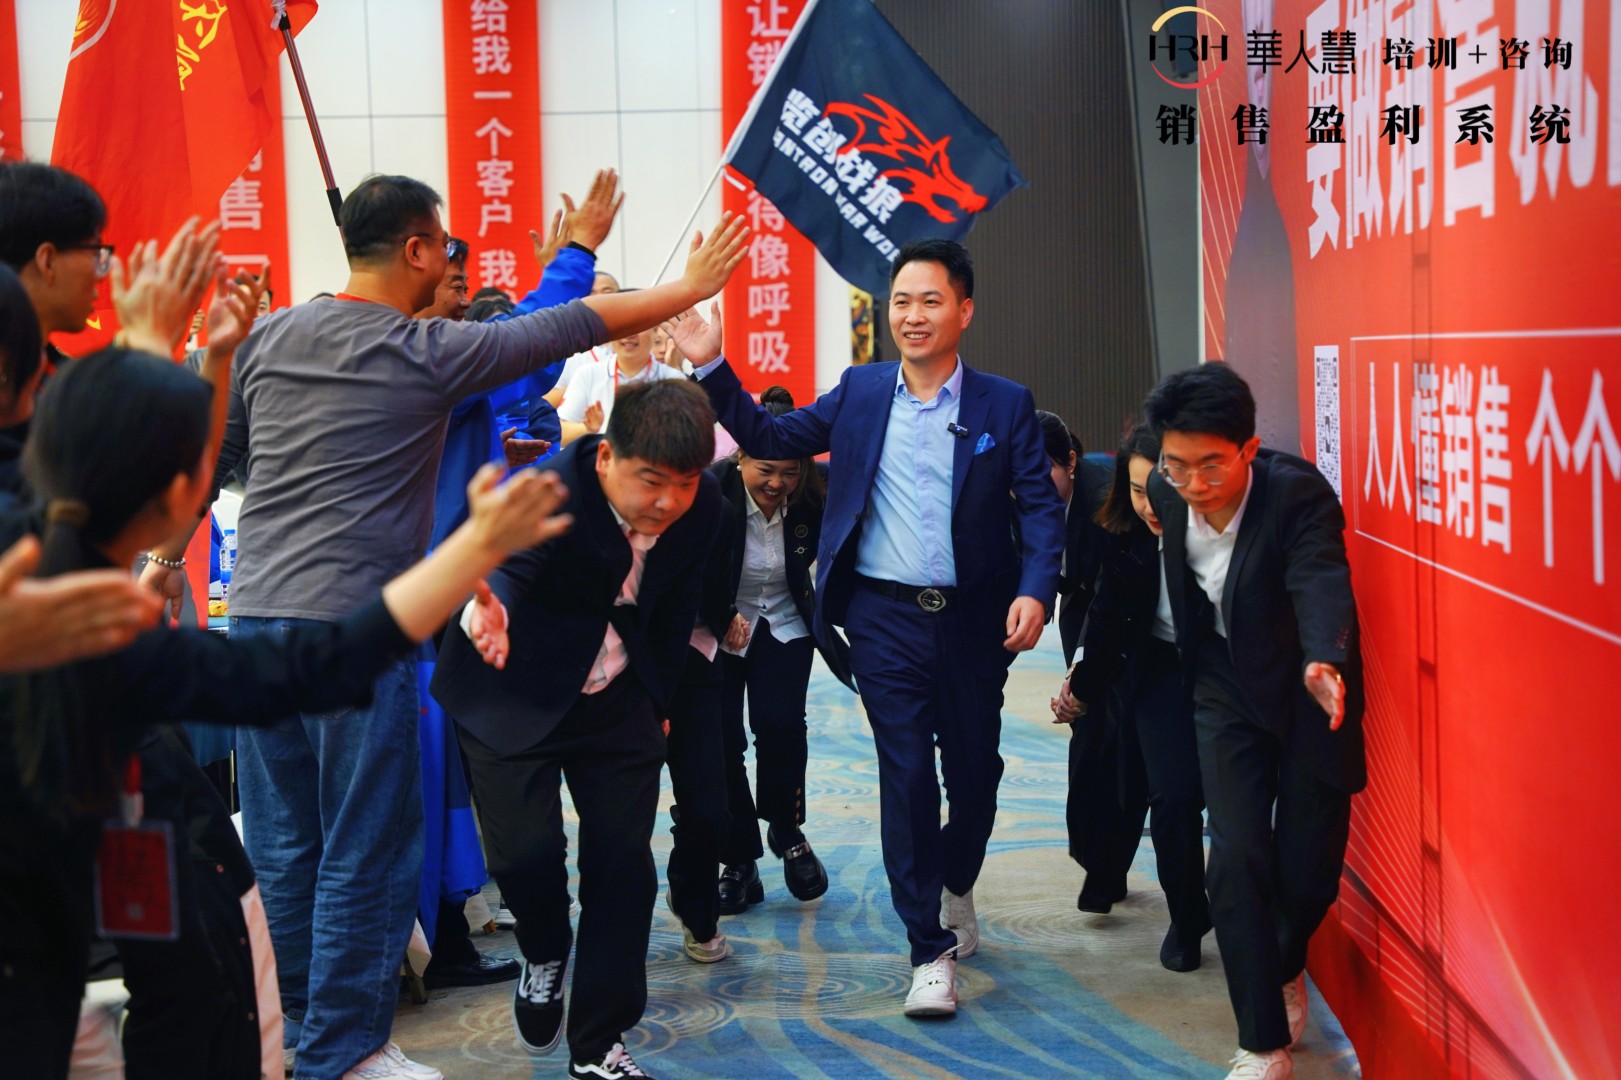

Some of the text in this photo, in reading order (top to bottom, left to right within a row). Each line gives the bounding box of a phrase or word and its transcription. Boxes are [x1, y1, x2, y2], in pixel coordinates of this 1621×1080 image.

[470, 0, 514, 238] 给我一个客户
[1305, 0, 1621, 261] 要做销售就
[1525, 366, 1621, 586] 个个
